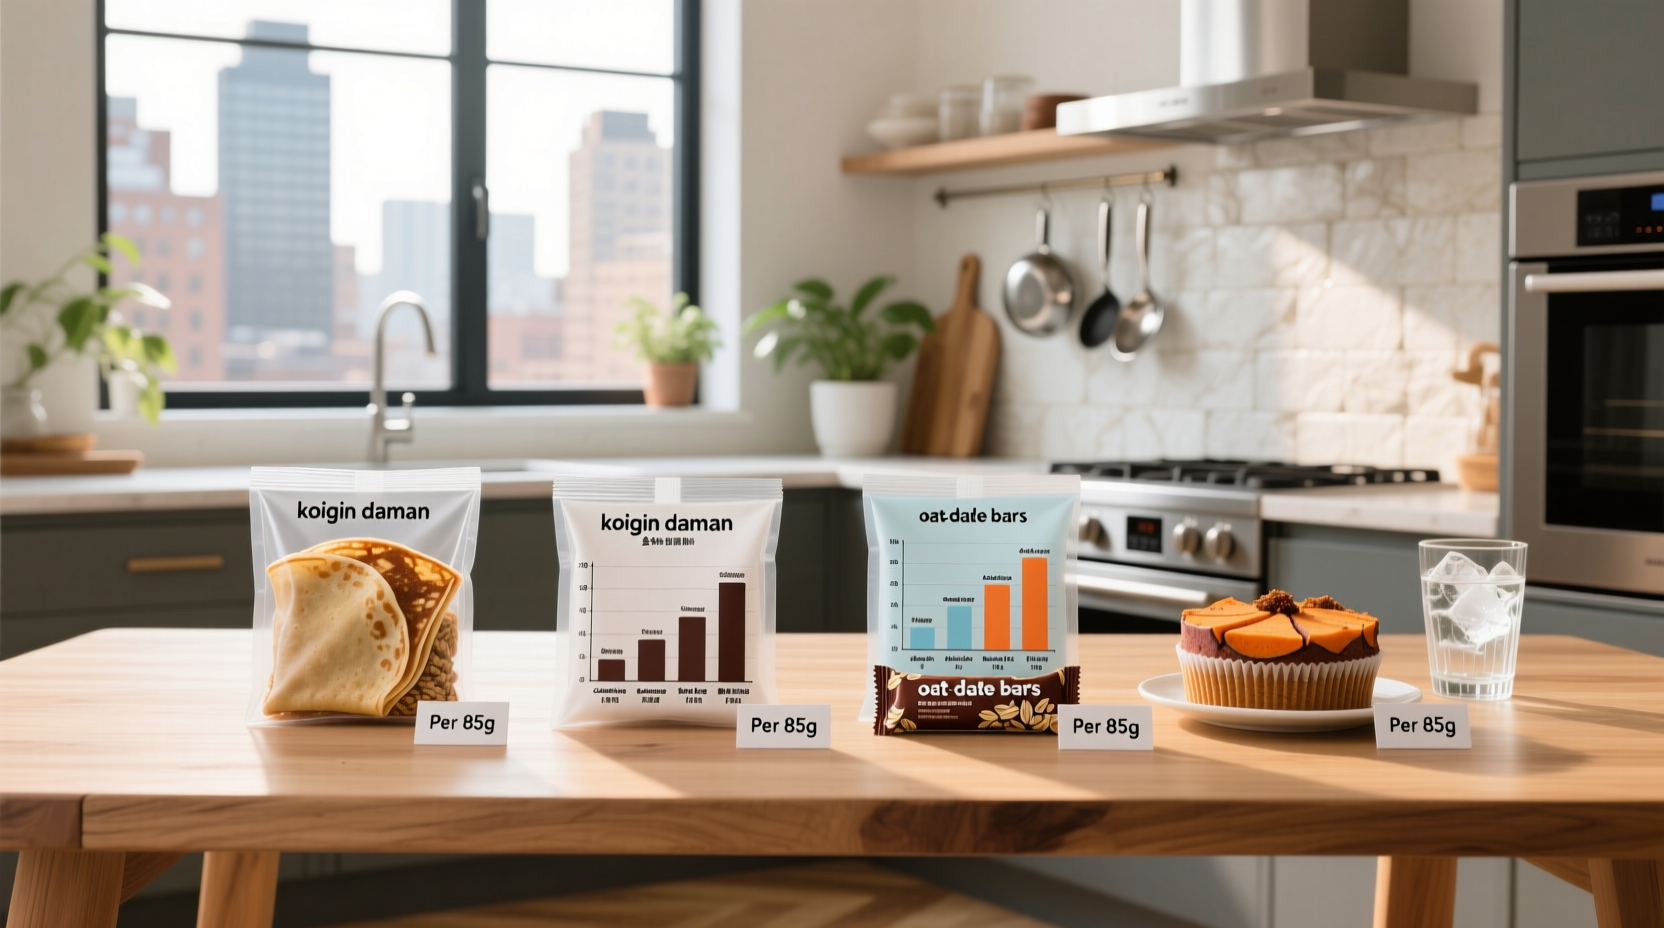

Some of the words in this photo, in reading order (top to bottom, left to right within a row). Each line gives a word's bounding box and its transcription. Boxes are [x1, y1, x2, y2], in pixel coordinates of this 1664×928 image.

[297, 500, 356, 525] koigin
[361, 501, 430, 520] daman
[991, 507, 1028, 523] bars
[601, 513, 660, 536] koigin
[664, 513, 733, 531] daman
[1000, 679, 1041, 697] bars
[429, 714, 459, 730] Per
[462, 714, 495, 735] 85g
[751, 717, 780, 733] Per
[784, 717, 817, 739] 85g
[1073, 717, 1102, 734] Per
[1106, 717, 1140, 740] 85g
[1389, 716, 1419, 733] Per
[1422, 716, 1456, 738] 85g
